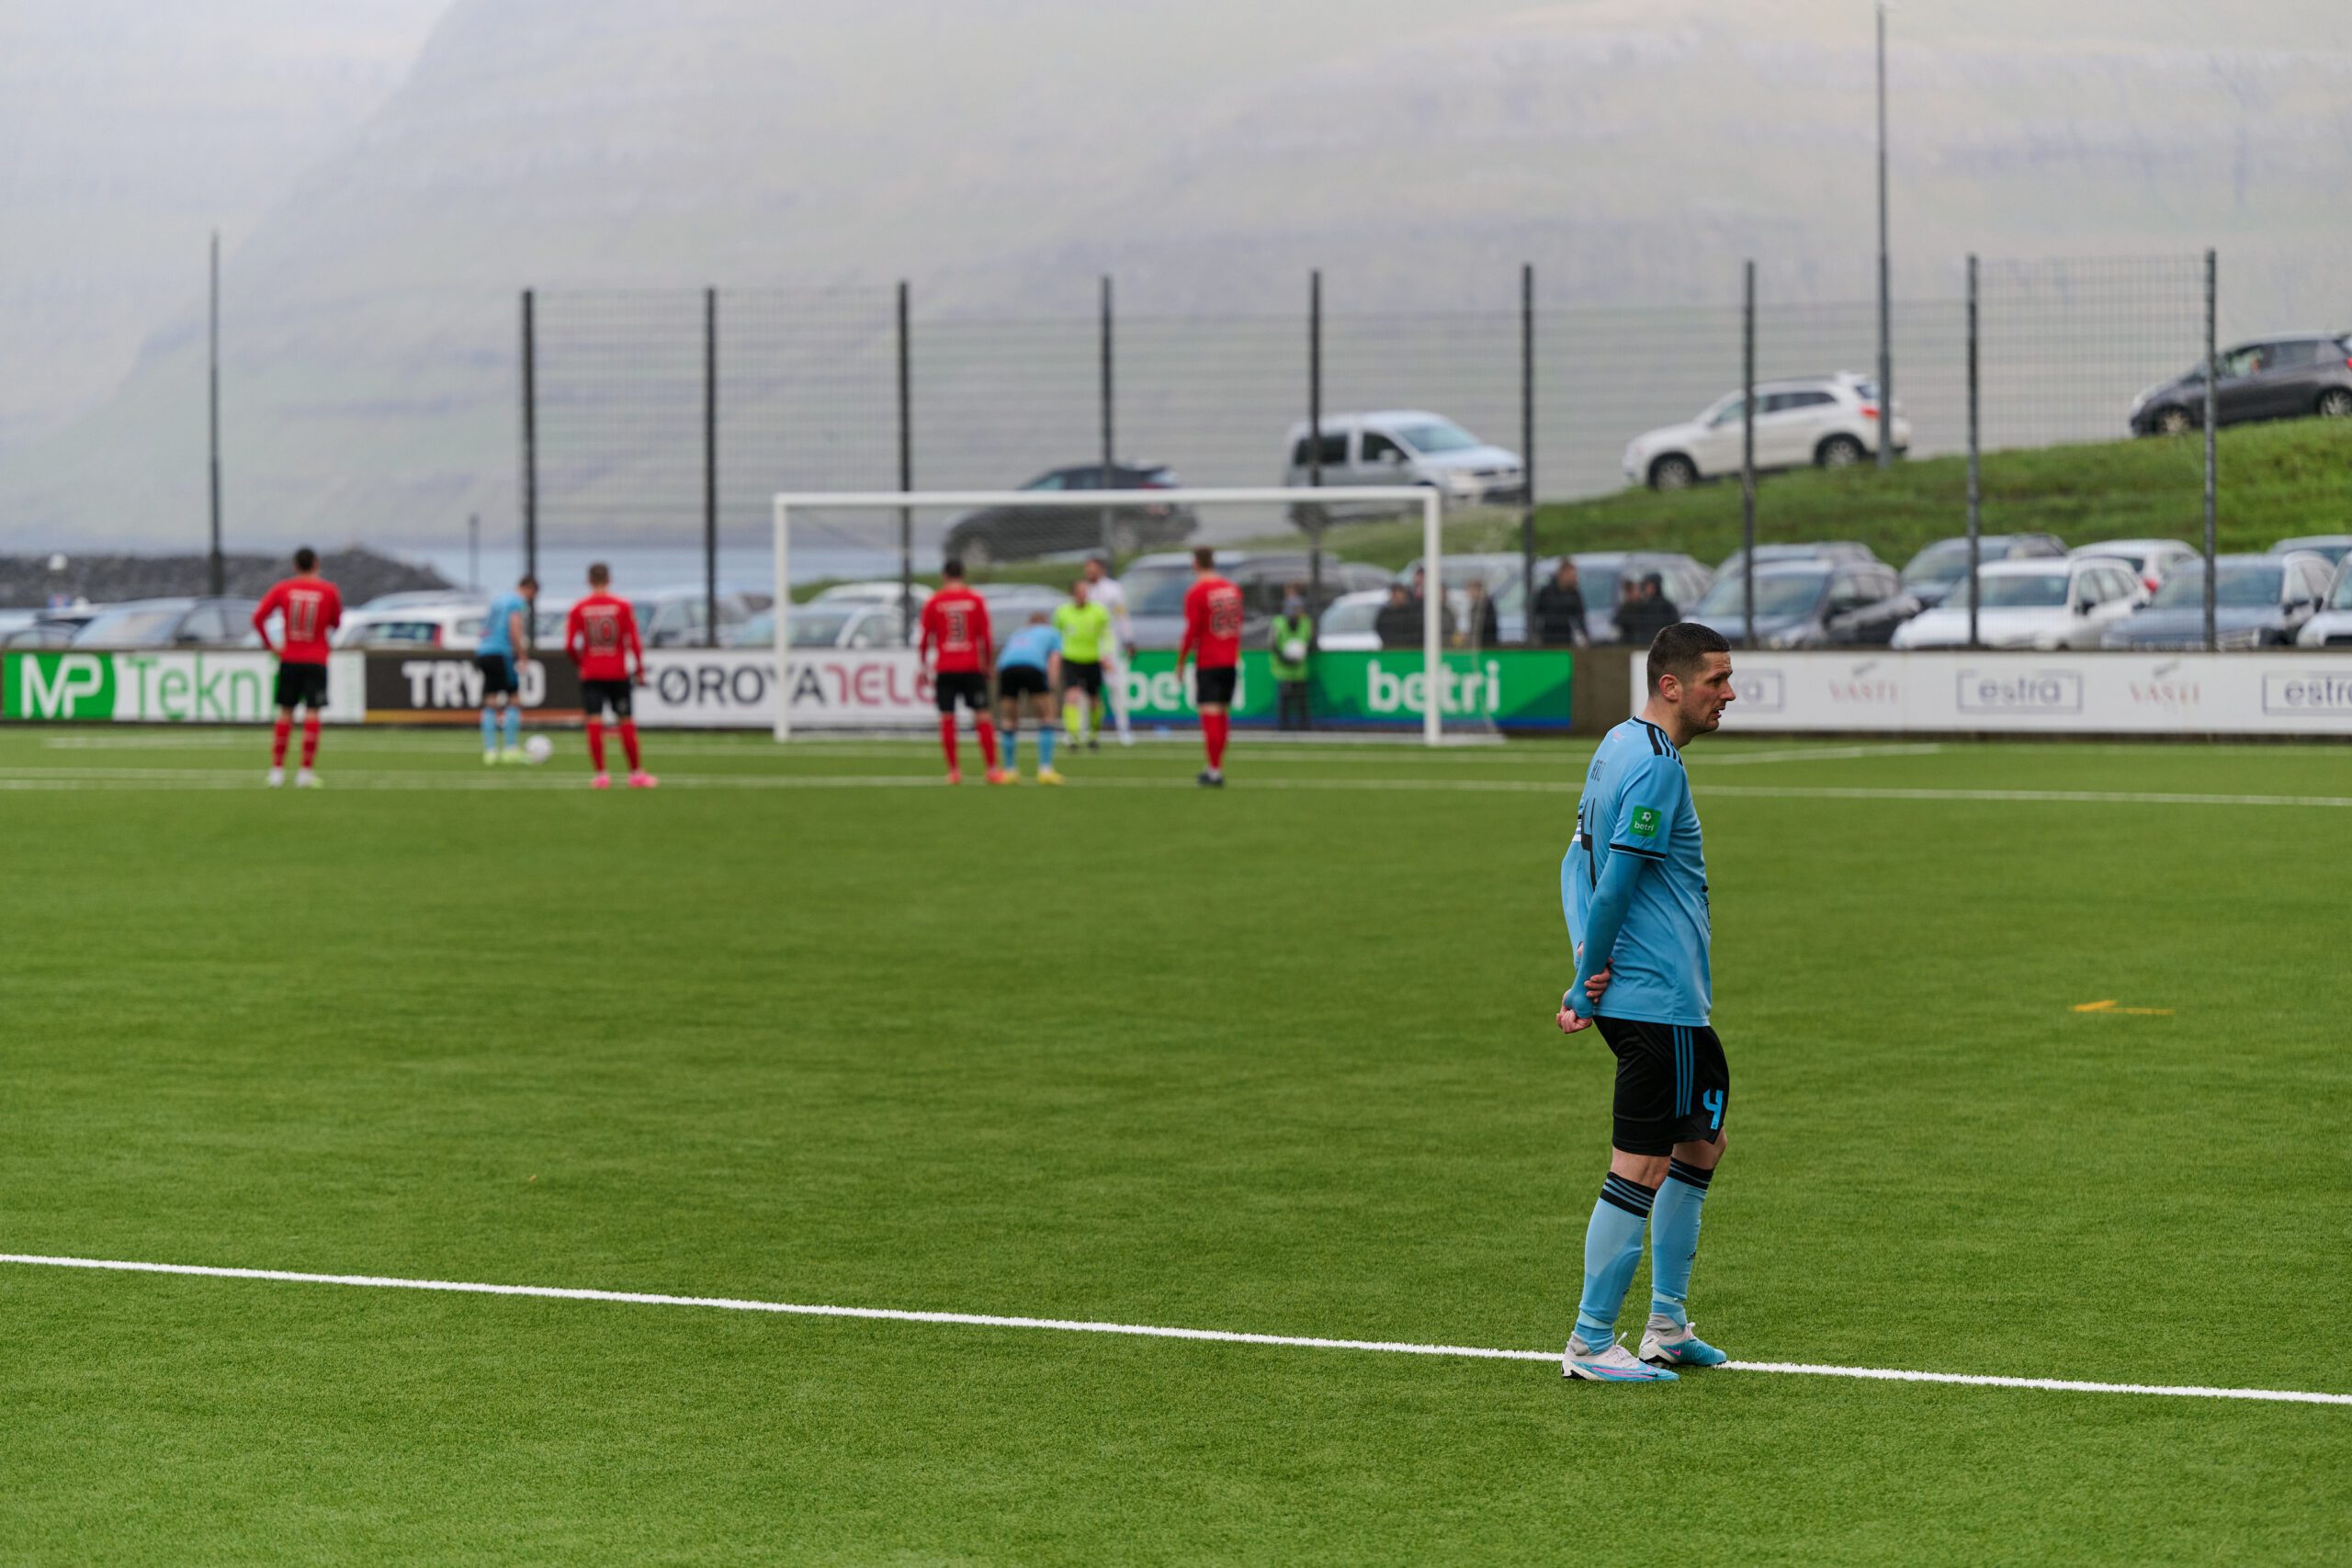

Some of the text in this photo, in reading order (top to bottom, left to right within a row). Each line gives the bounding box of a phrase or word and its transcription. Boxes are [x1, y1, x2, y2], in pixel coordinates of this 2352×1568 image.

[20, 653, 103, 719] MP
[126, 652, 281, 721] Tekni
[401, 660, 546, 708] TRYD
[1978, 674, 2062, 705] estra
[2284, 674, 2352, 706] estr
[1703, 1089, 1724, 1130] 4
